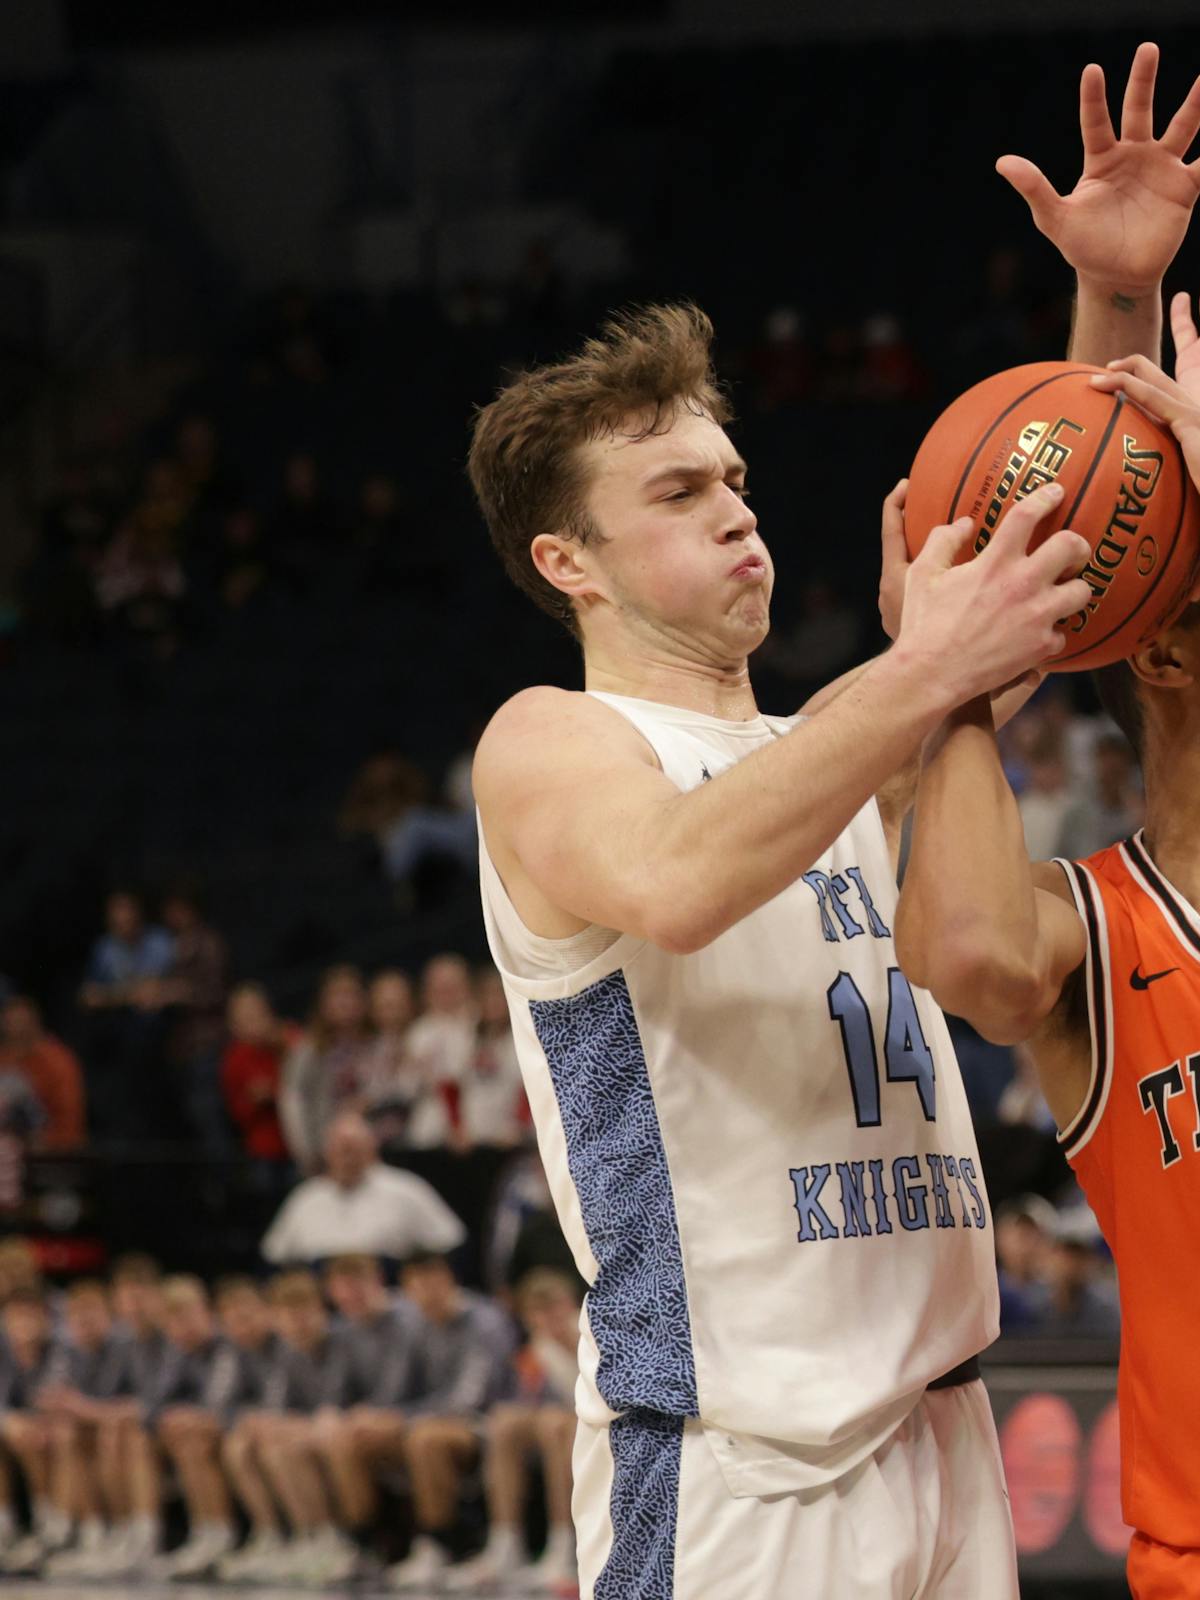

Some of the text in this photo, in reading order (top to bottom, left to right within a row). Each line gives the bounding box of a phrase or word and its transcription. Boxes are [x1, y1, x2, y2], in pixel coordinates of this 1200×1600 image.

[1013, 416, 1086, 503] LEG
[826, 966, 936, 1128] 14
[789, 1154, 987, 1243] KNIGHTS
